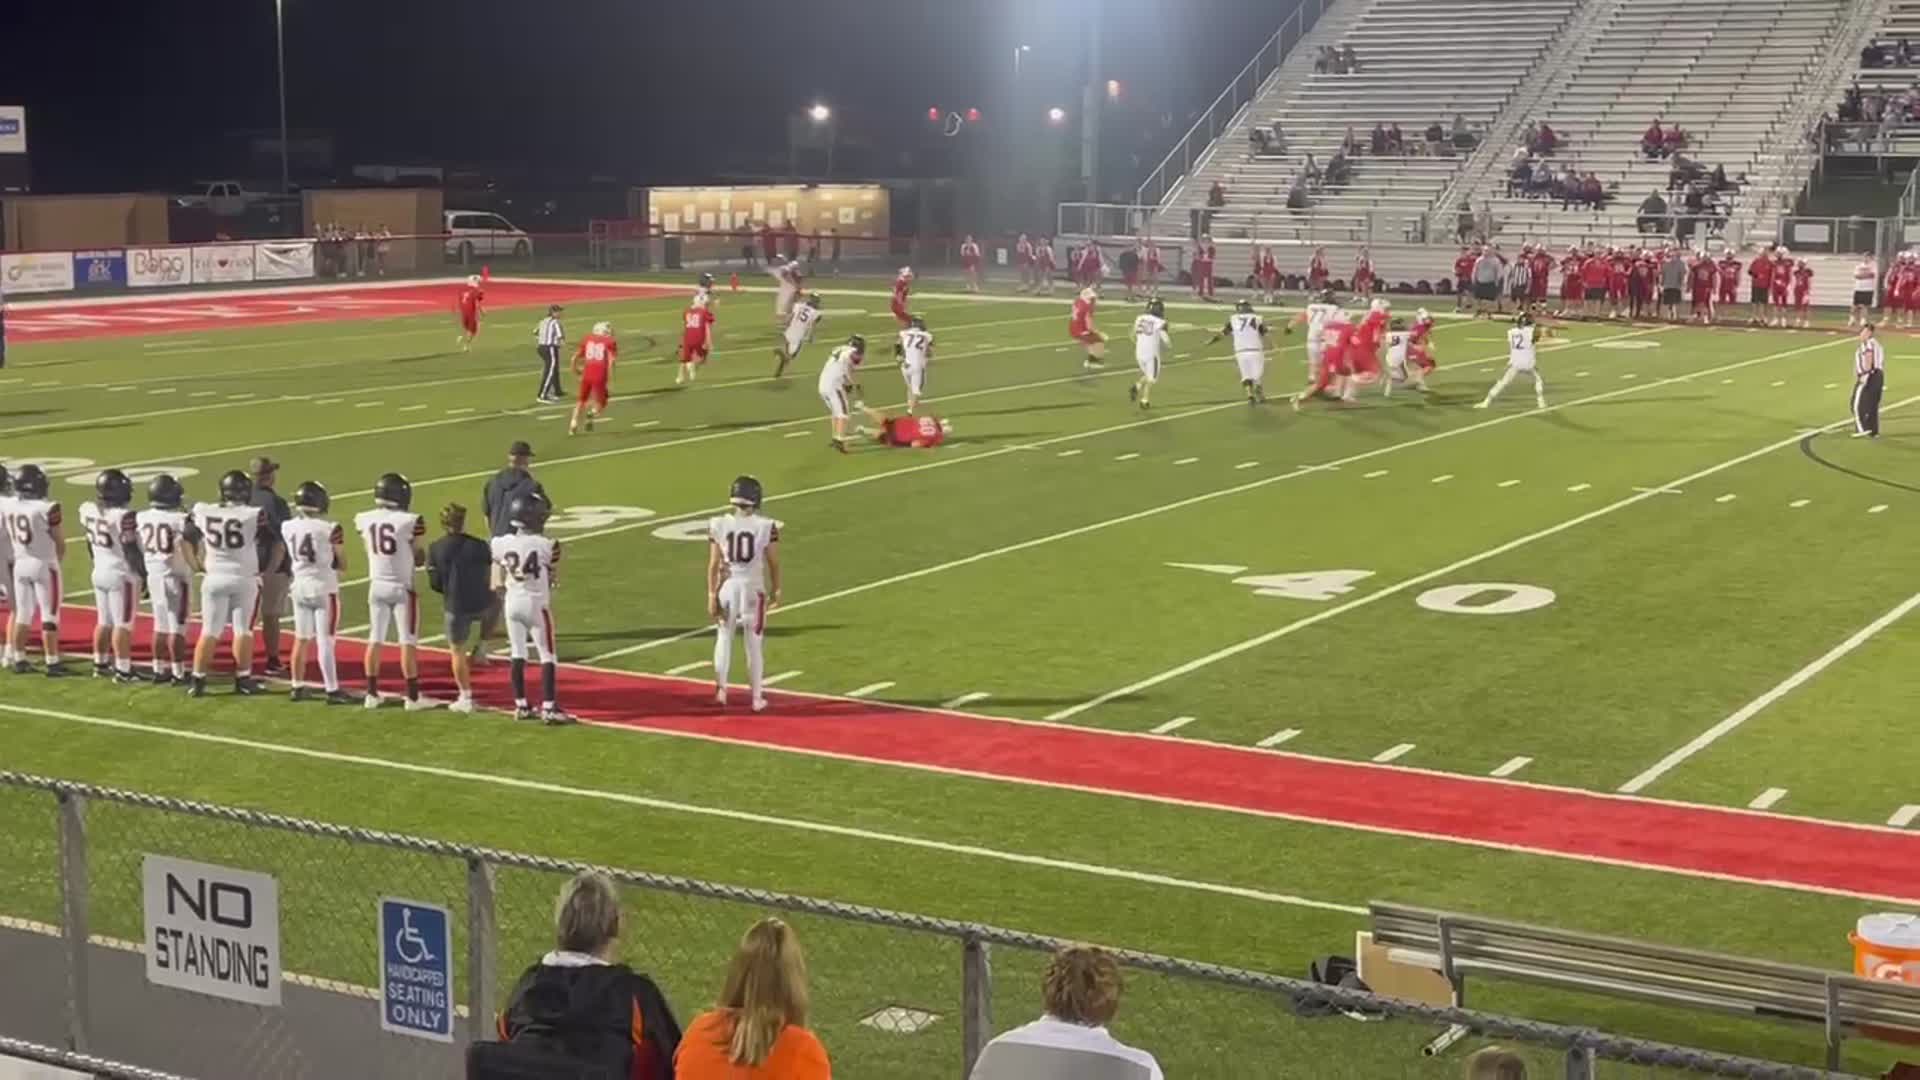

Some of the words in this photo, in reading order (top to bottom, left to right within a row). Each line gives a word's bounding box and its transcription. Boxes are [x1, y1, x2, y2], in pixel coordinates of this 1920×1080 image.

[1239, 317, 1257, 331] 74
[907, 333, 925, 350] 72
[8, 513, 32, 545] 19
[85, 516, 113, 548] 55
[142, 522, 173, 554] 20
[205, 516, 245, 549] 56
[368, 523, 397, 555] 16
[289, 533, 317, 564] 14
[726, 531, 755, 563] 10
[503, 550, 542, 582] 24
[166, 872, 252, 929] NO
[155, 926, 269, 989] STANDING
[387, 965, 445, 988] HANDICAPPED
[388, 982, 445, 1009] SEATING
[392, 1004, 442, 1029] ONLY
